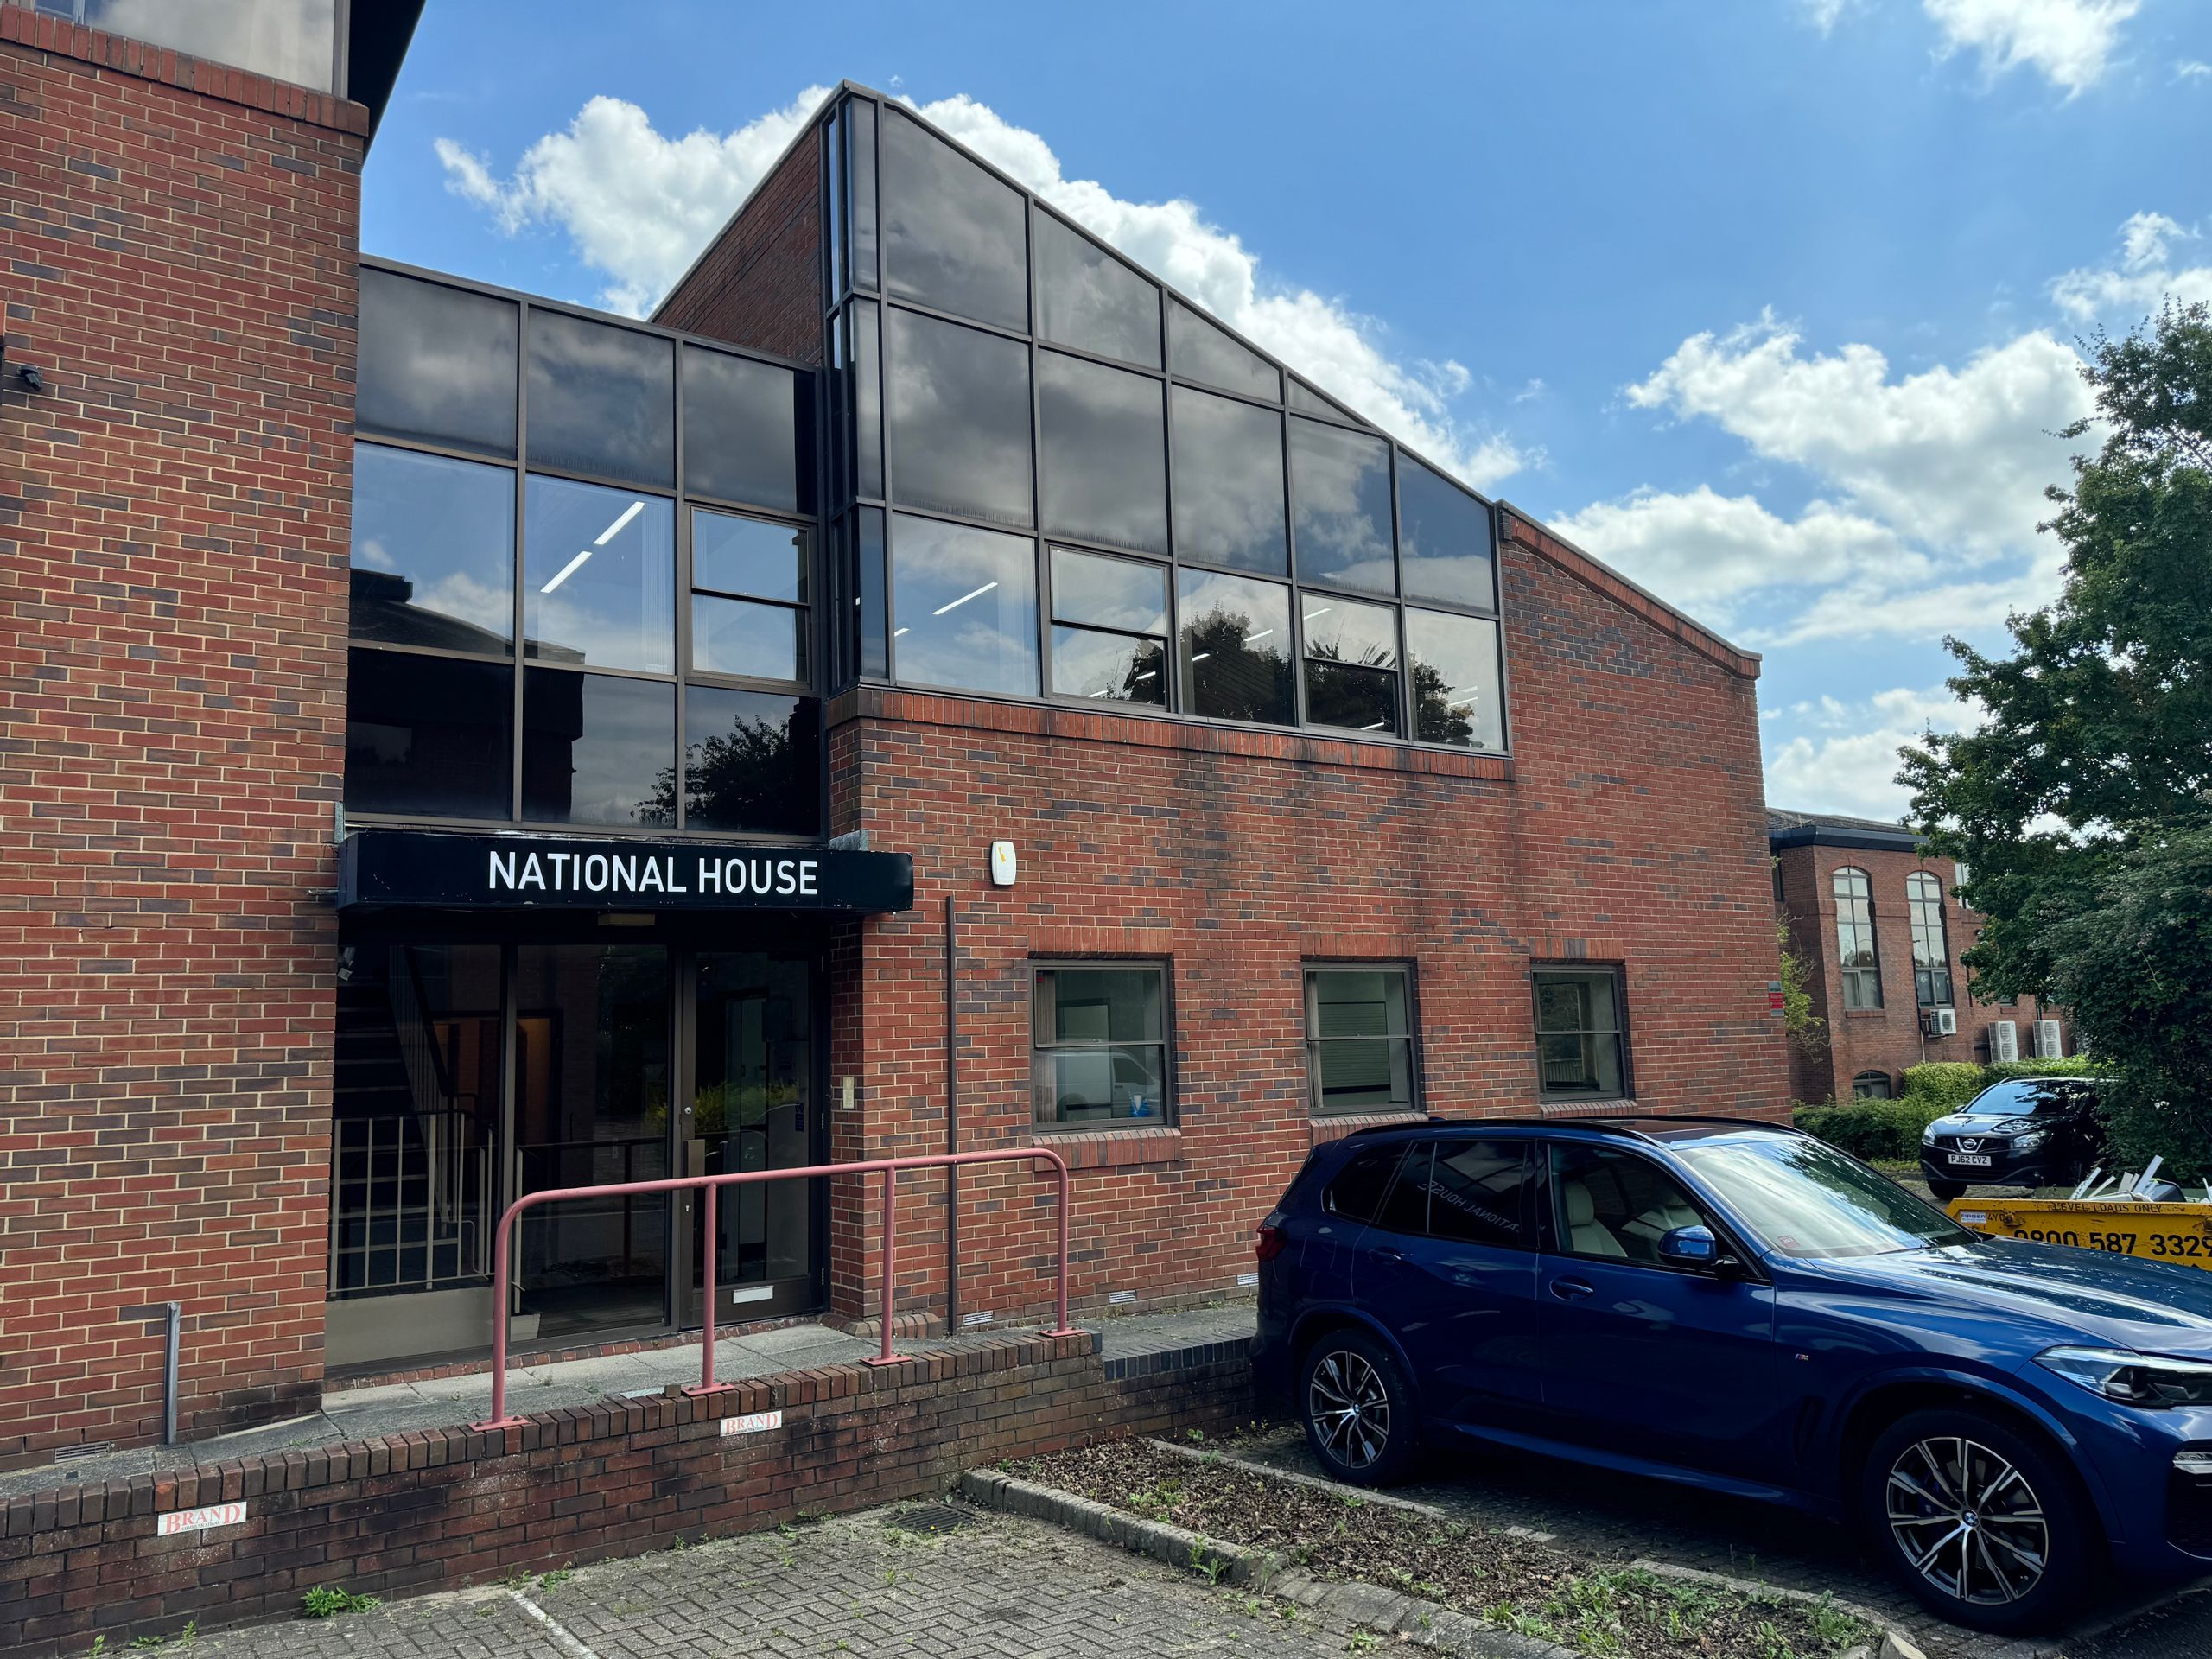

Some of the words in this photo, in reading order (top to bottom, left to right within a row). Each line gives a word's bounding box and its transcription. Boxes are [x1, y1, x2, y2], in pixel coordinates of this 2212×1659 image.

[489, 851, 687, 893] NATIONAL
[698, 858, 818, 895] HOUSE
[1972, 1156, 1987, 1165] CVZ
[2052, 1203, 2086, 1211] LEVEL
[2094, 1204, 2130, 1213] LOADS
[2134, 1205, 2162, 1213] ONLY
[2089, 1232, 2137, 1254] 587
[726, 1414, 778, 1435] BRAND
[165, 1505, 241, 1534] BRAND
